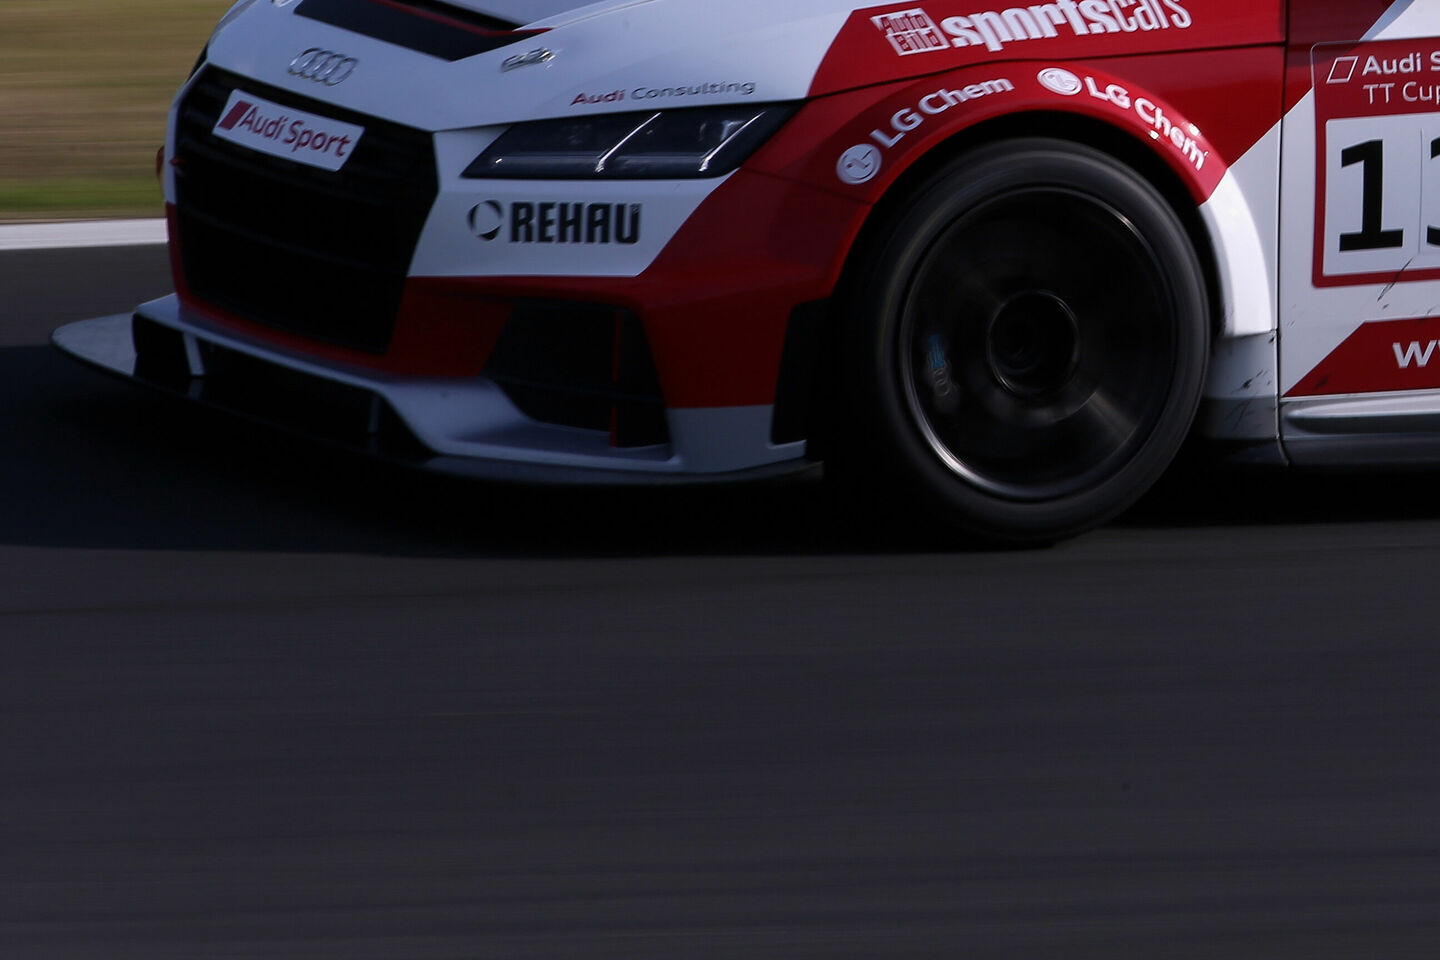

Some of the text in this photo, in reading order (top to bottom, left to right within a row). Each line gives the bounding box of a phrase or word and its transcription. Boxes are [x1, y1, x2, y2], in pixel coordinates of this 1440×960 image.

[1362, 53, 1422, 76] Audi
[571, 78, 756, 106] Audi Consulting
[870, 77, 1015, 148] LG Chem
[1363, 83, 1395, 104] TT
[239, 104, 351, 158] Audi Sport
[1083, 76, 1209, 172] LG Chem
[508, 201, 641, 243] REHAU
